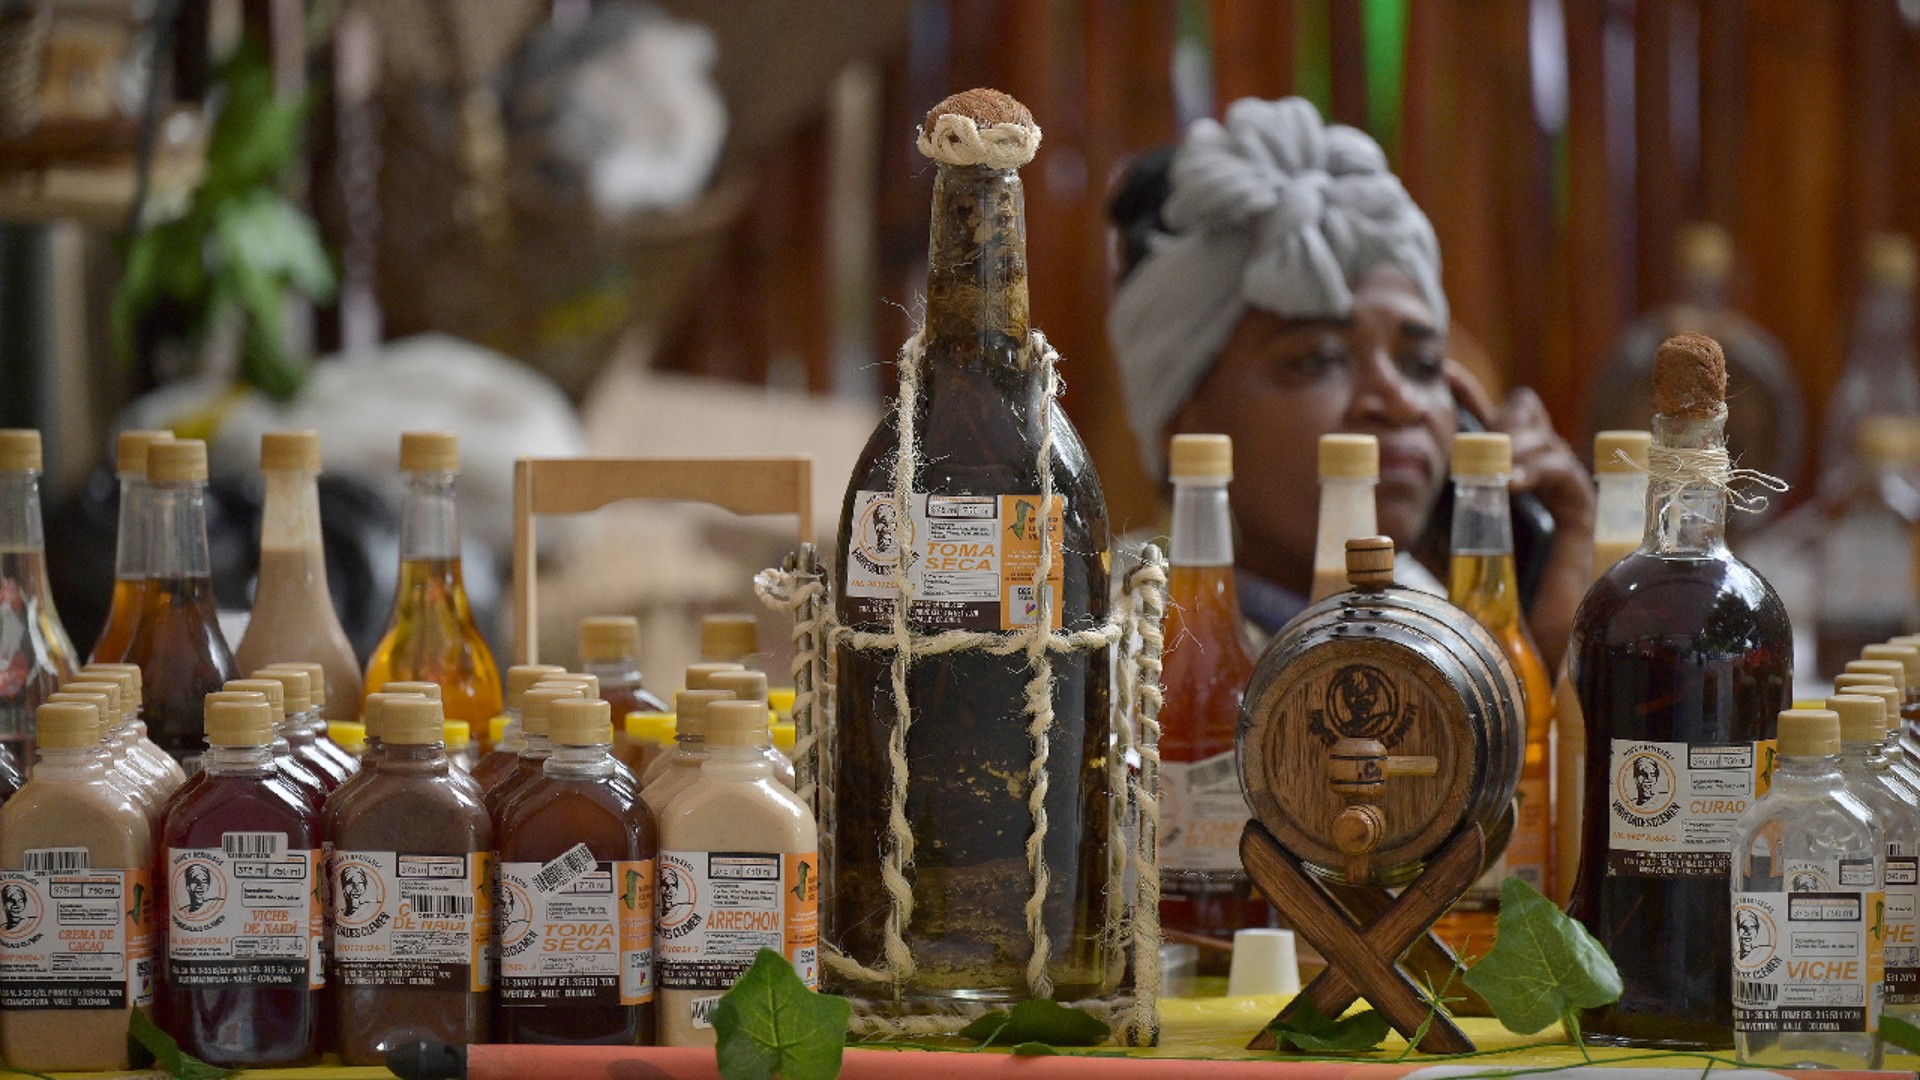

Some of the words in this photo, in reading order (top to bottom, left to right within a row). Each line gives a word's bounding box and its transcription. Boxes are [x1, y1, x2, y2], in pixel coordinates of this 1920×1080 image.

[926, 542, 995, 557] TOMA
[924, 558, 992, 571] SECA
[251, 909, 289, 922] VICHE
[706, 910, 780, 931] ARRECHON
[242, 923, 260, 935] DE
[392, 917, 416, 930] DE
[543, 923, 615, 936] TOMA
[58, 930, 97, 940] CREMA
[98, 930, 114, 940] DE
[68, 941, 105, 953] CACAO
[541, 938, 612, 952] SECA
[1786, 960, 1860, 981] VICHE
